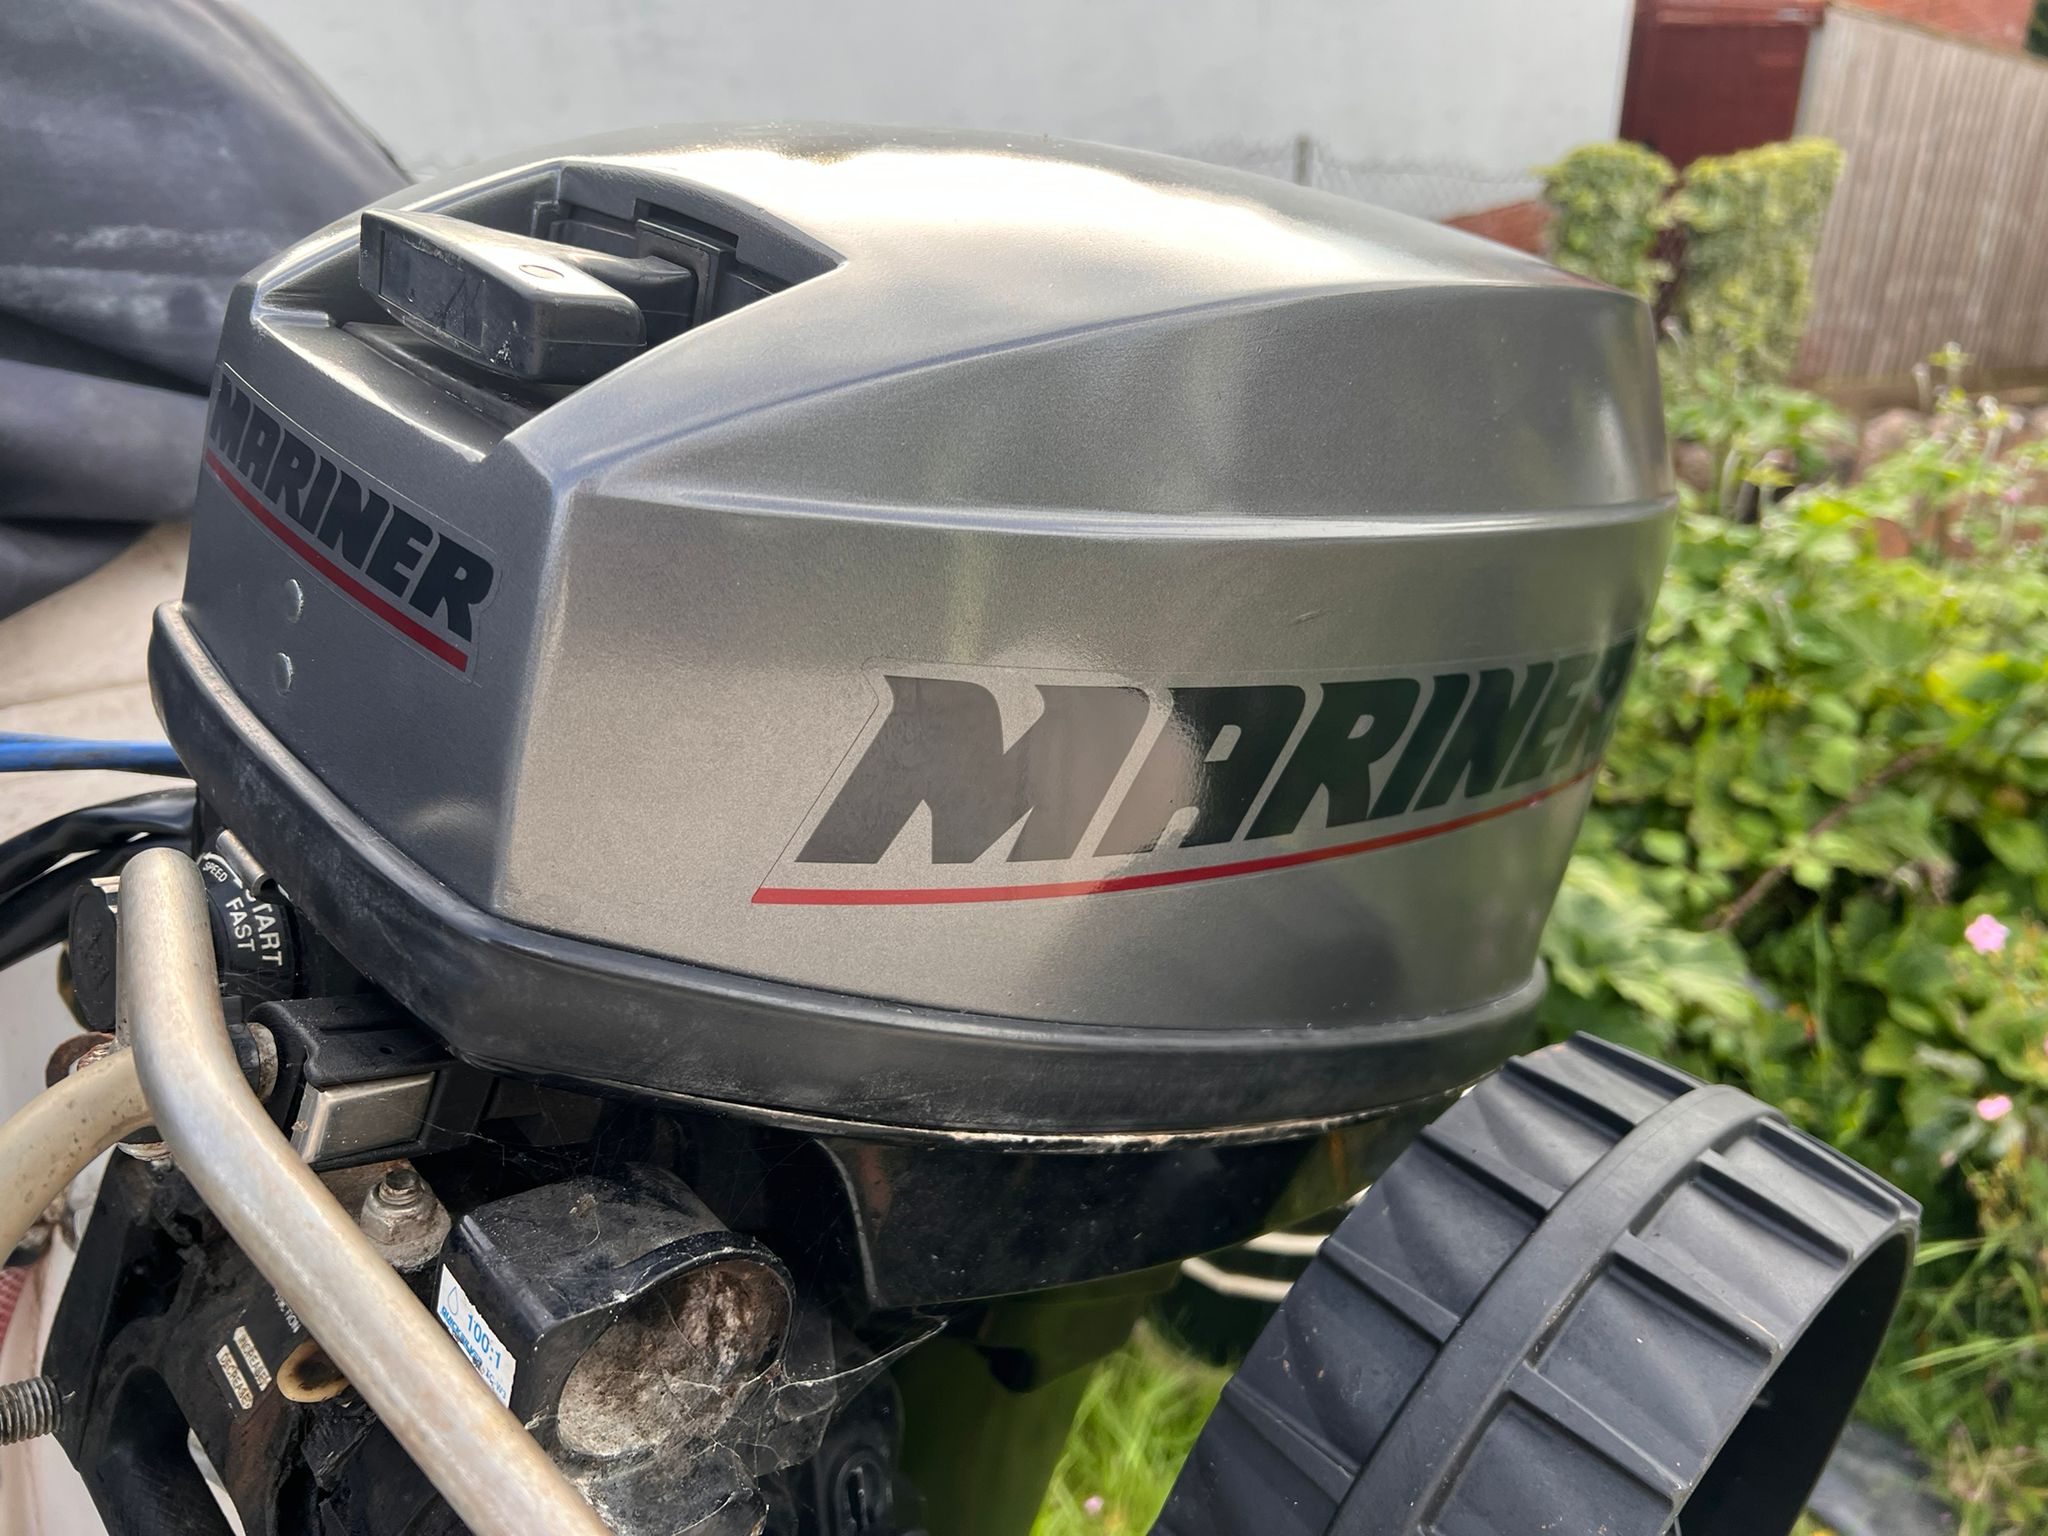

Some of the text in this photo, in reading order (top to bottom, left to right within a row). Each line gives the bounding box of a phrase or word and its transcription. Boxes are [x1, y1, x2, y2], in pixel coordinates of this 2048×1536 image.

[208, 372, 495, 643] MARINER
[796, 640, 1636, 865] MARINER
[203, 861, 228, 882] SPEED
[225, 896, 255, 951] FAST
[468, 1313, 501, 1369] 100:1
[220, 1352, 251, 1404] DECREASE
